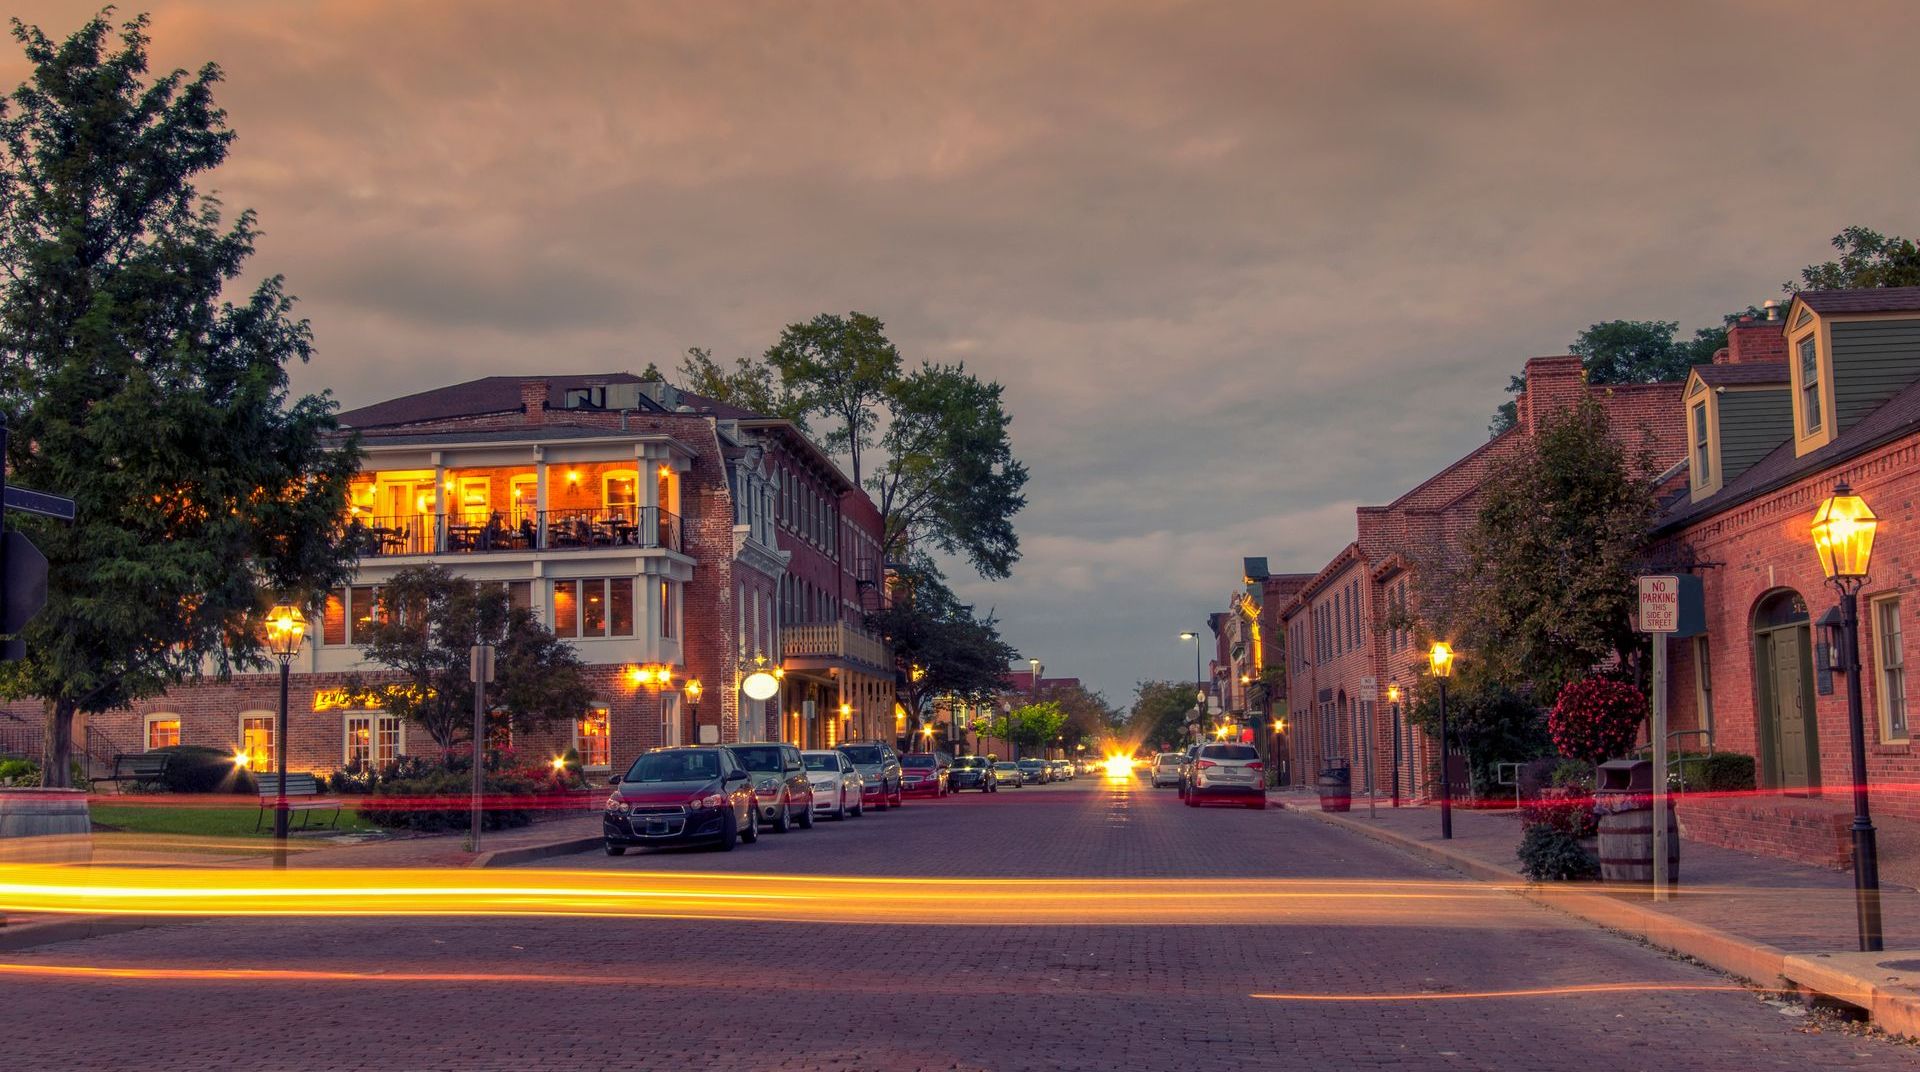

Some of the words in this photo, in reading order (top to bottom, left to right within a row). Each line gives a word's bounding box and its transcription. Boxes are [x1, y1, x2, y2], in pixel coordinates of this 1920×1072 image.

[1652, 581, 1666, 592] NO
[1642, 592, 1676, 603] PARKING
[1652, 603, 1667, 611] THIS
[1646, 611, 1661, 619] SIDE
[1663, 611, 1673, 619] OF
[1647, 619, 1672, 627] STREET
